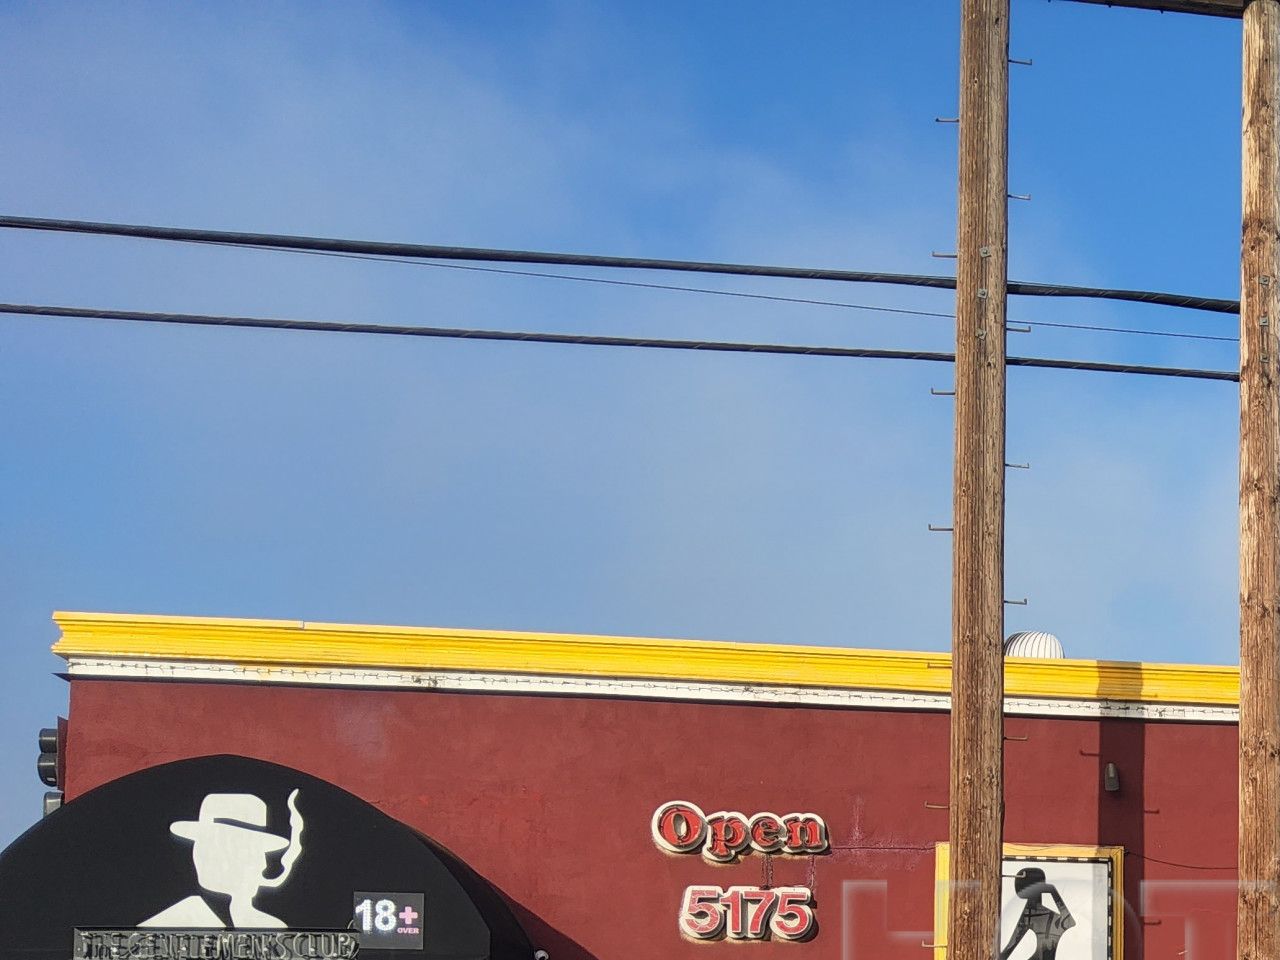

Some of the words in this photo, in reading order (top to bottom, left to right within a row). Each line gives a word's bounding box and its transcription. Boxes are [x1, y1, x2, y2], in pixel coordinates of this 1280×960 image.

[654, 801, 828, 860] Open
[396, 927, 420, 935] OVER
[681, 886, 814, 939] 5175
[79, 932, 127, 960] THE
